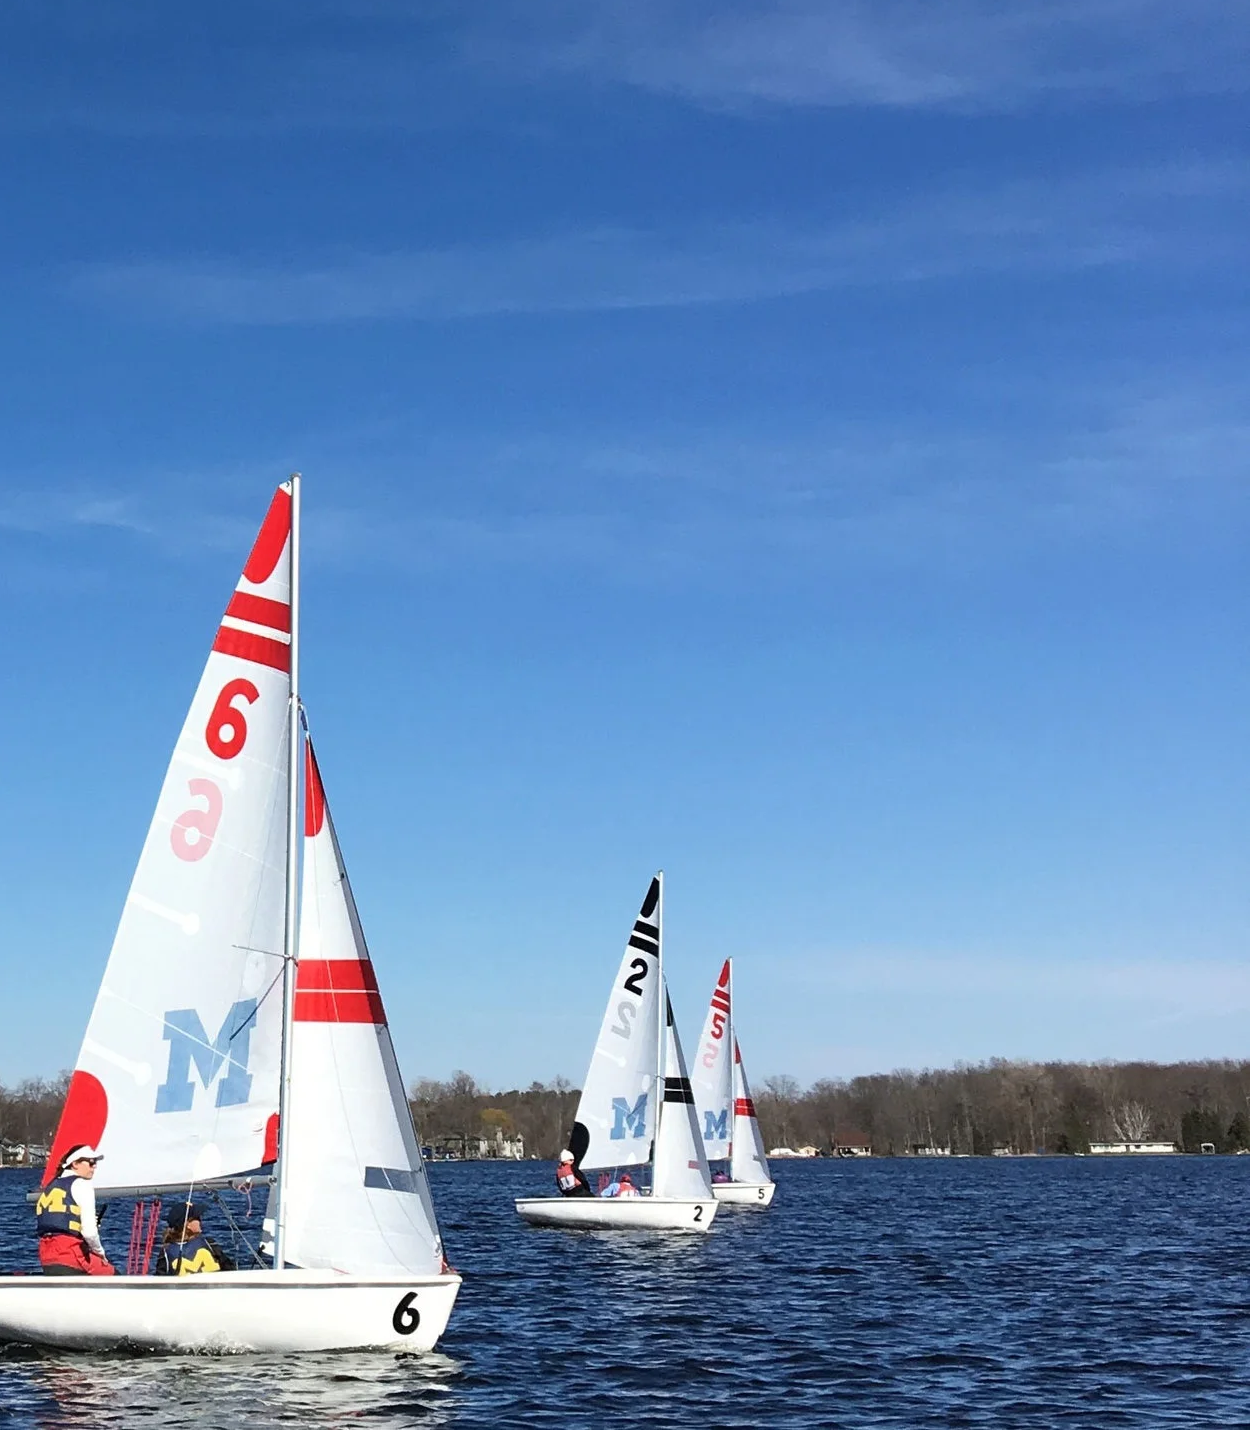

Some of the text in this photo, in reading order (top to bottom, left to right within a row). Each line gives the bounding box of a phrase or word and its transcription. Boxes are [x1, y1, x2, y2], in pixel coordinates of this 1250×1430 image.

[206, 678, 260, 760] 6
[624, 958, 648, 996] 2
[711, 1013, 726, 1039] 5
[154, 997, 257, 1113] M
[610, 1093, 648, 1140] M
[704, 1108, 728, 1140] M
[36, 1187, 67, 1215] M
[758, 1188, 765, 1200] 5
[693, 1205, 703, 1222] 2
[171, 1247, 221, 1276] M
[393, 1291, 420, 1335] 6
